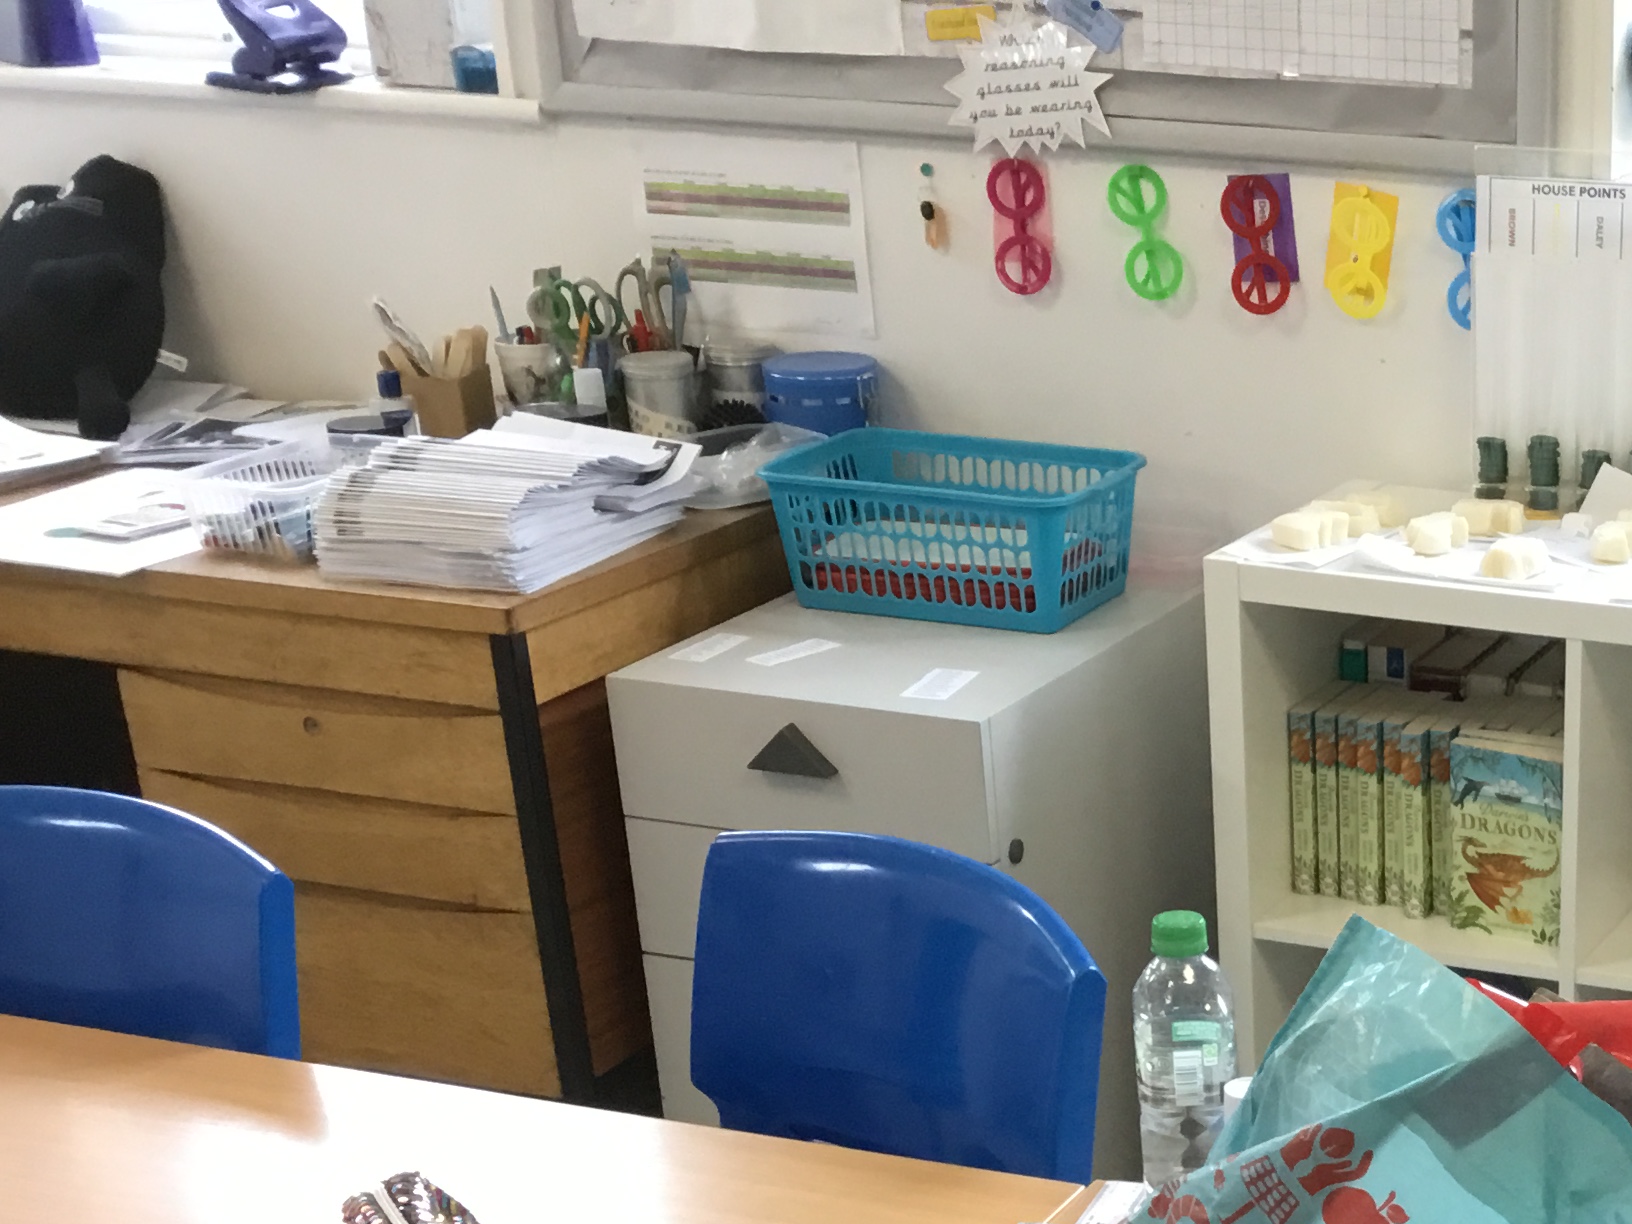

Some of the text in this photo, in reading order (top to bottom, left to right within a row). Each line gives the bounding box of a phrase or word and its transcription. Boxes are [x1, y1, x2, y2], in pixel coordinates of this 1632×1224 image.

[976, 75, 1080, 99] glasses will
[969, 99, 1093, 123] you be wearing
[1009, 122, 1061, 139] today?
[1532, 184, 1627, 199] HOUSE POINTS
[1508, 208, 1516, 247] BROWN
[1460, 813, 1558, 845] DRAGONS
